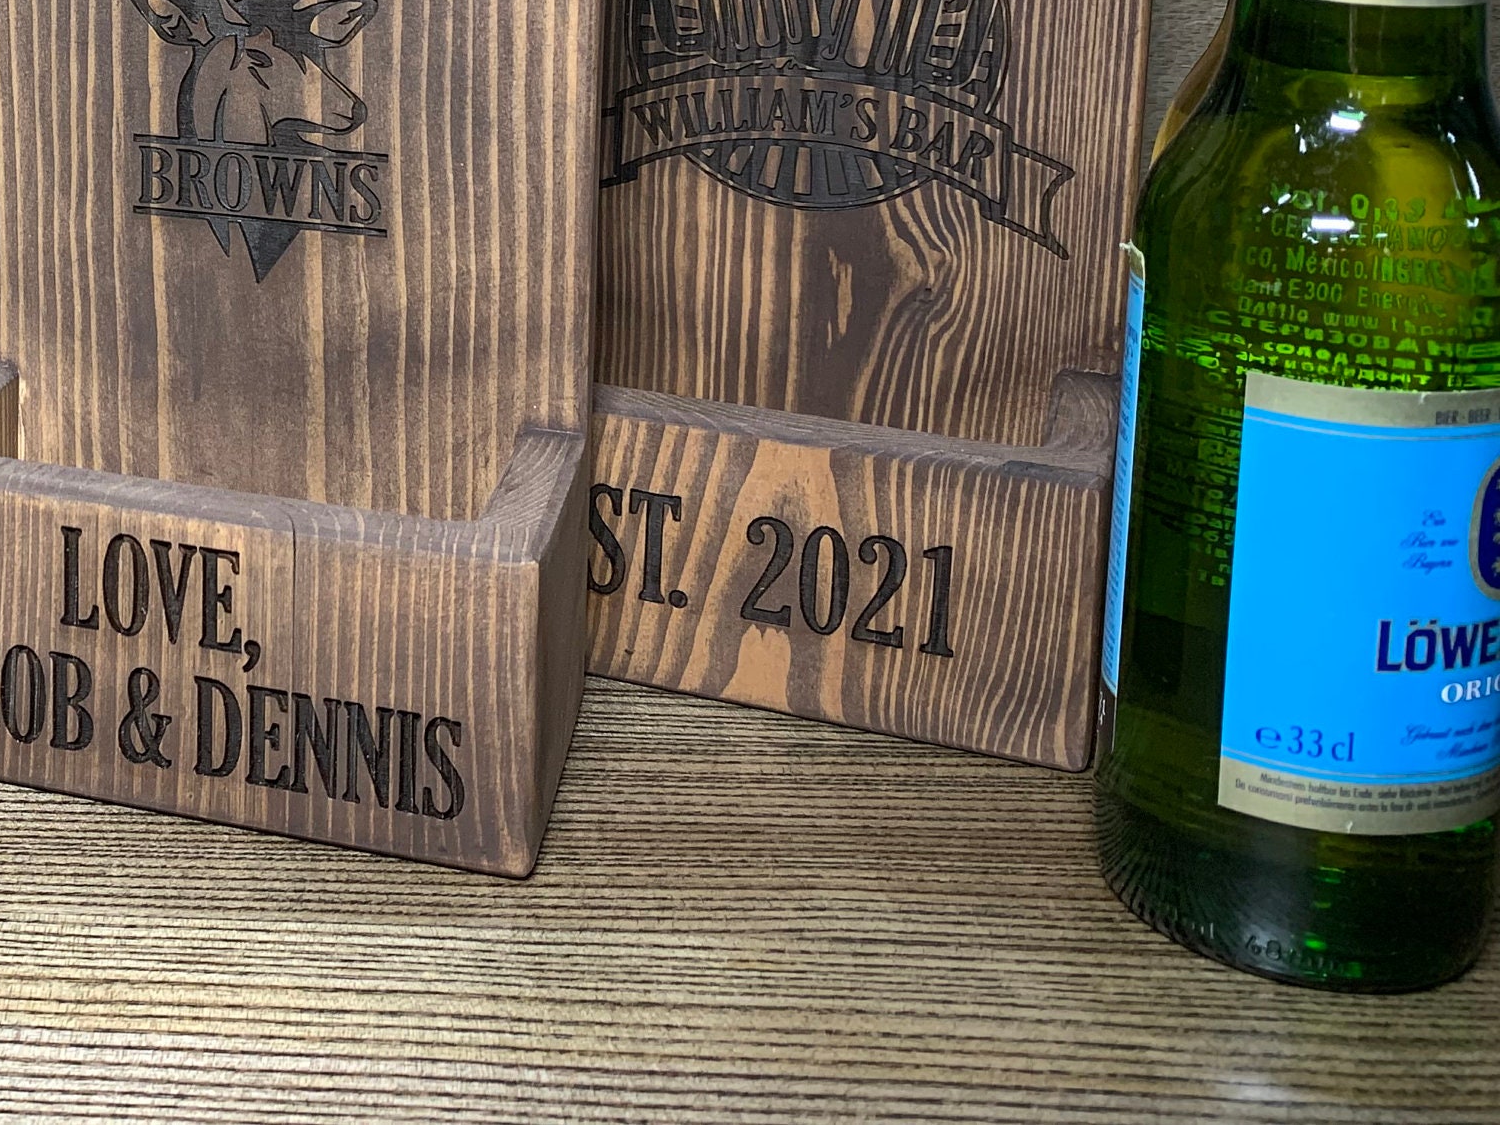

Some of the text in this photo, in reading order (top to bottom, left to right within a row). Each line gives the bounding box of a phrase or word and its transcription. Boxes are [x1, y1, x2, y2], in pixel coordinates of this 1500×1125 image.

[138, 145, 382, 226] BROWNS
[631, 86, 996, 182] WILLIAM'S BAR
[60, 525, 262, 674] LOVE,
[740, 516, 955, 659] 2021
[117, 667, 173, 770] &
[193, 674, 467, 822] DENNIS
